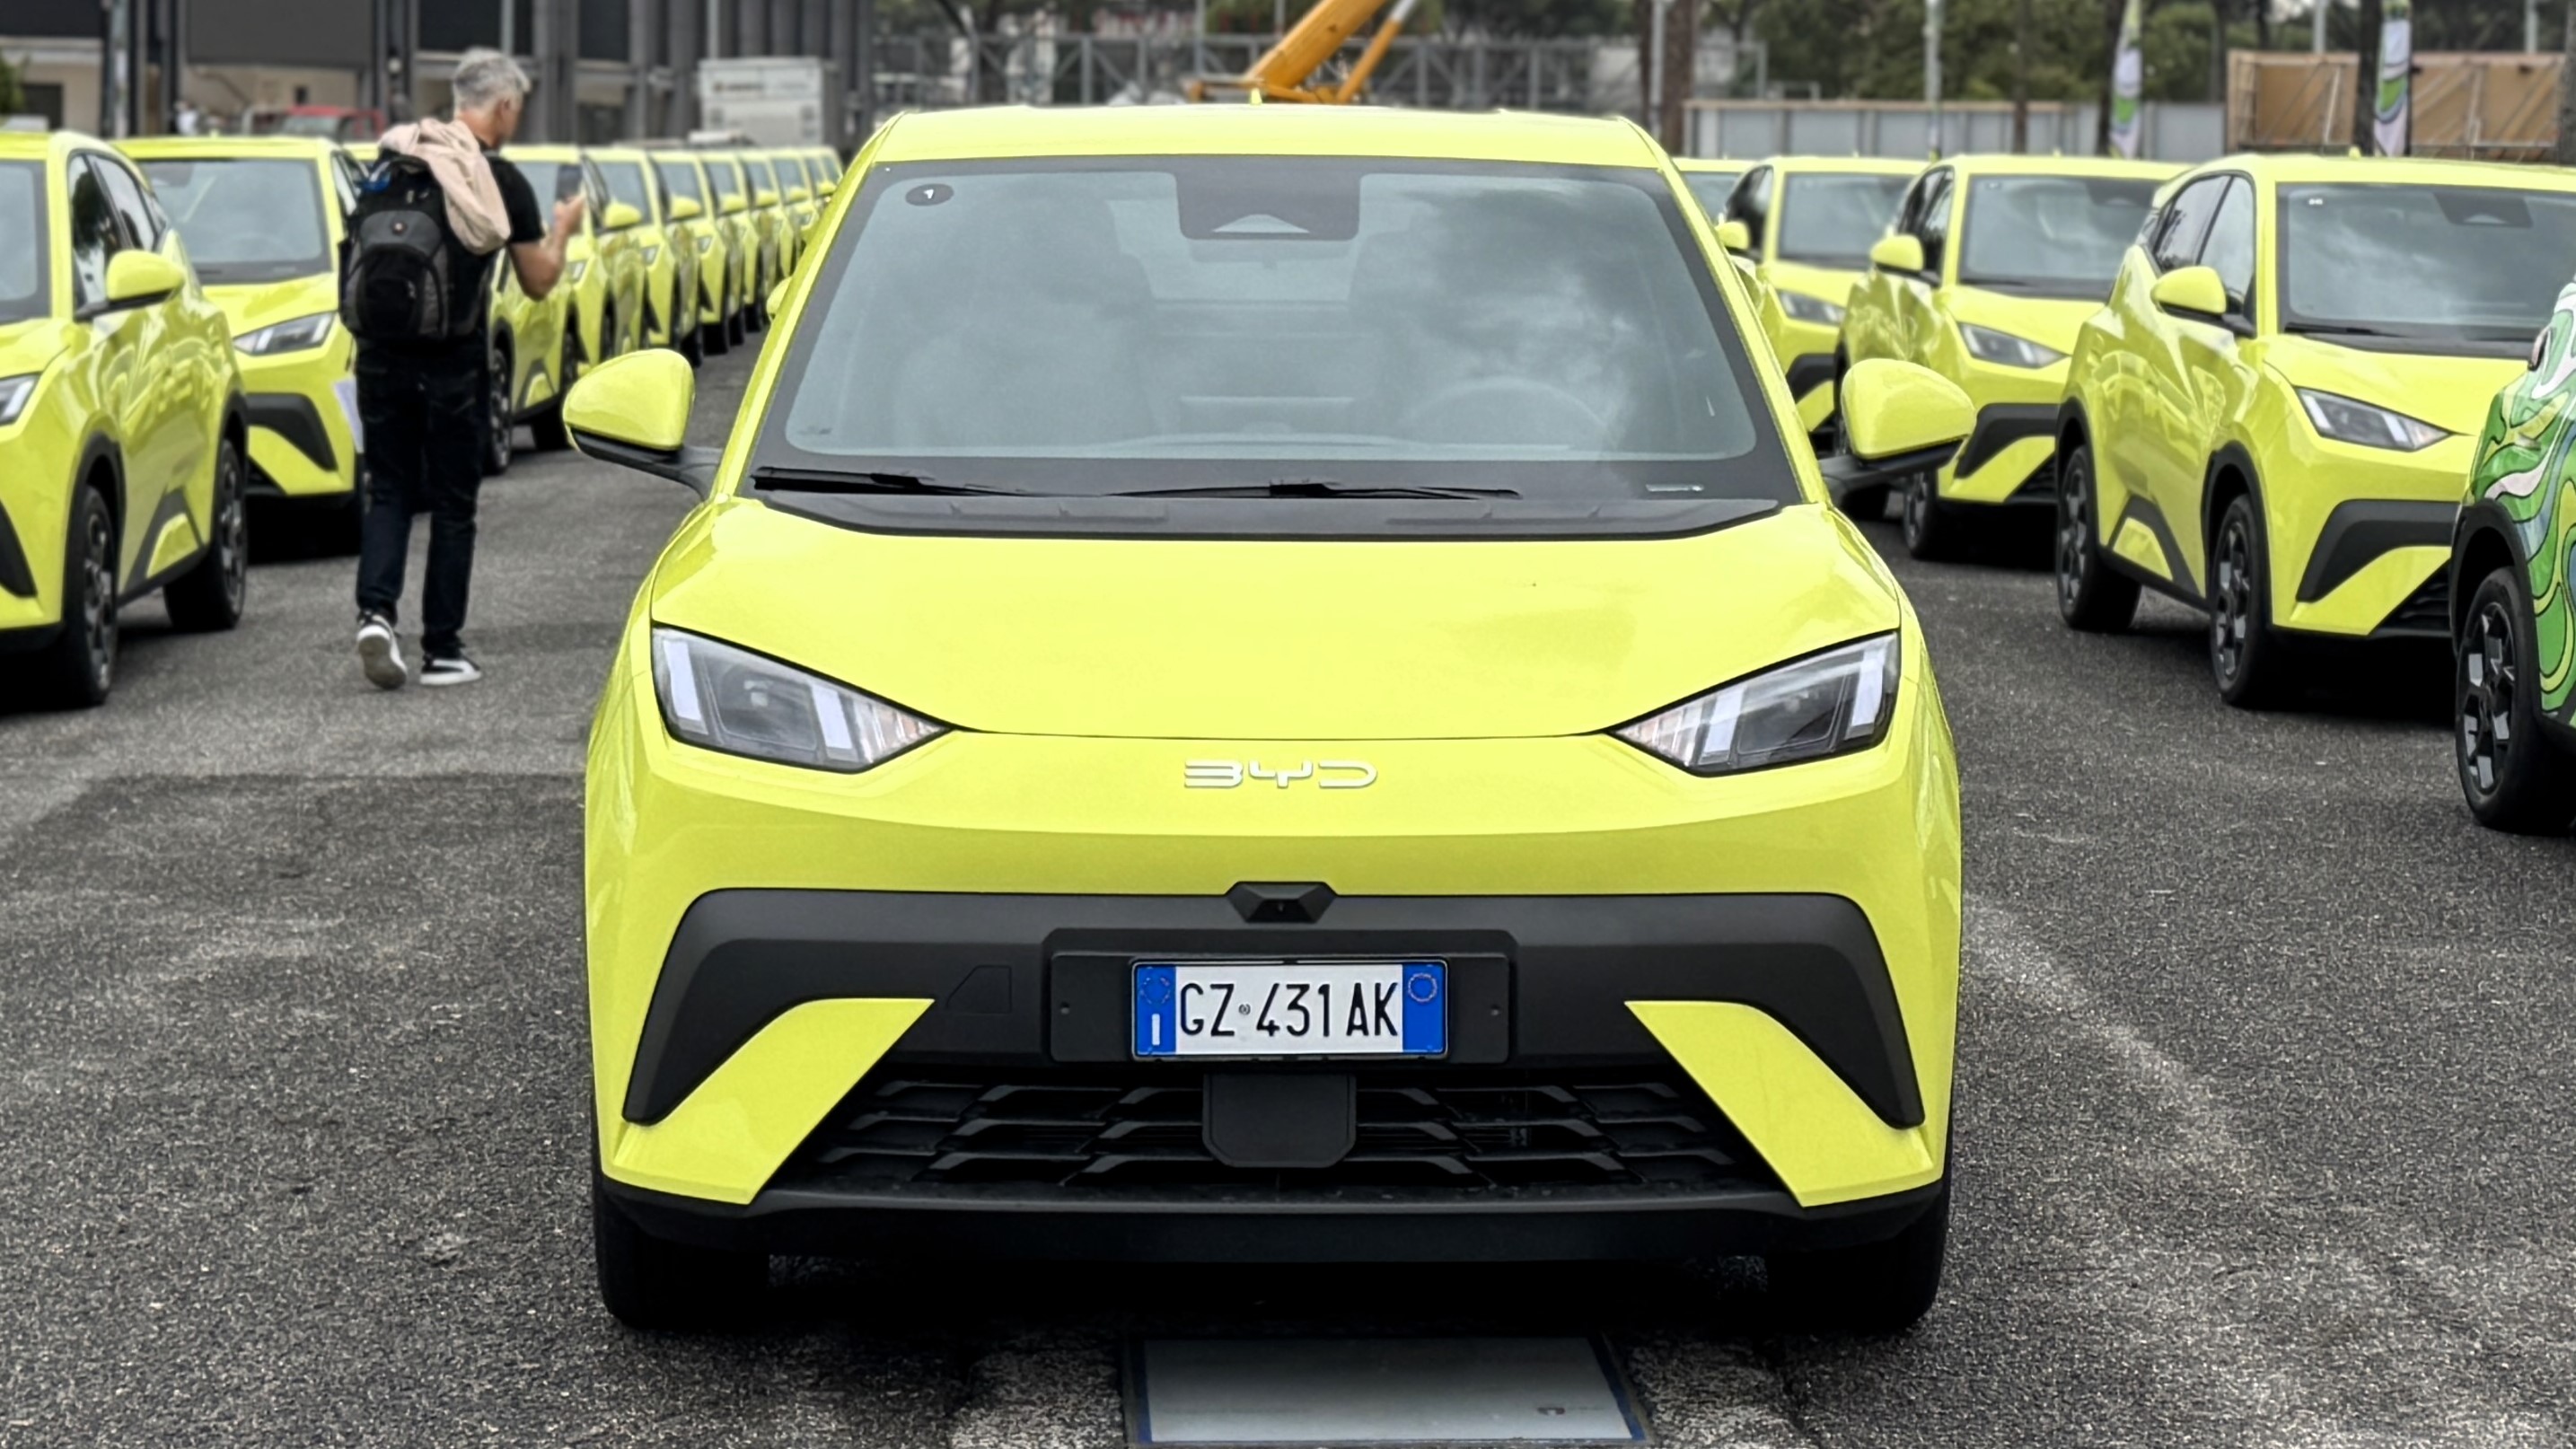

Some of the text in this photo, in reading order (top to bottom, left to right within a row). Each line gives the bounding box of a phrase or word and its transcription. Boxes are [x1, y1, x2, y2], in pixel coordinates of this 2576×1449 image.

[1184, 760, 1378, 789] BYD
[1180, 982, 1398, 1037] GZ 431 AK
[1151, 1013, 1161, 1046] I
